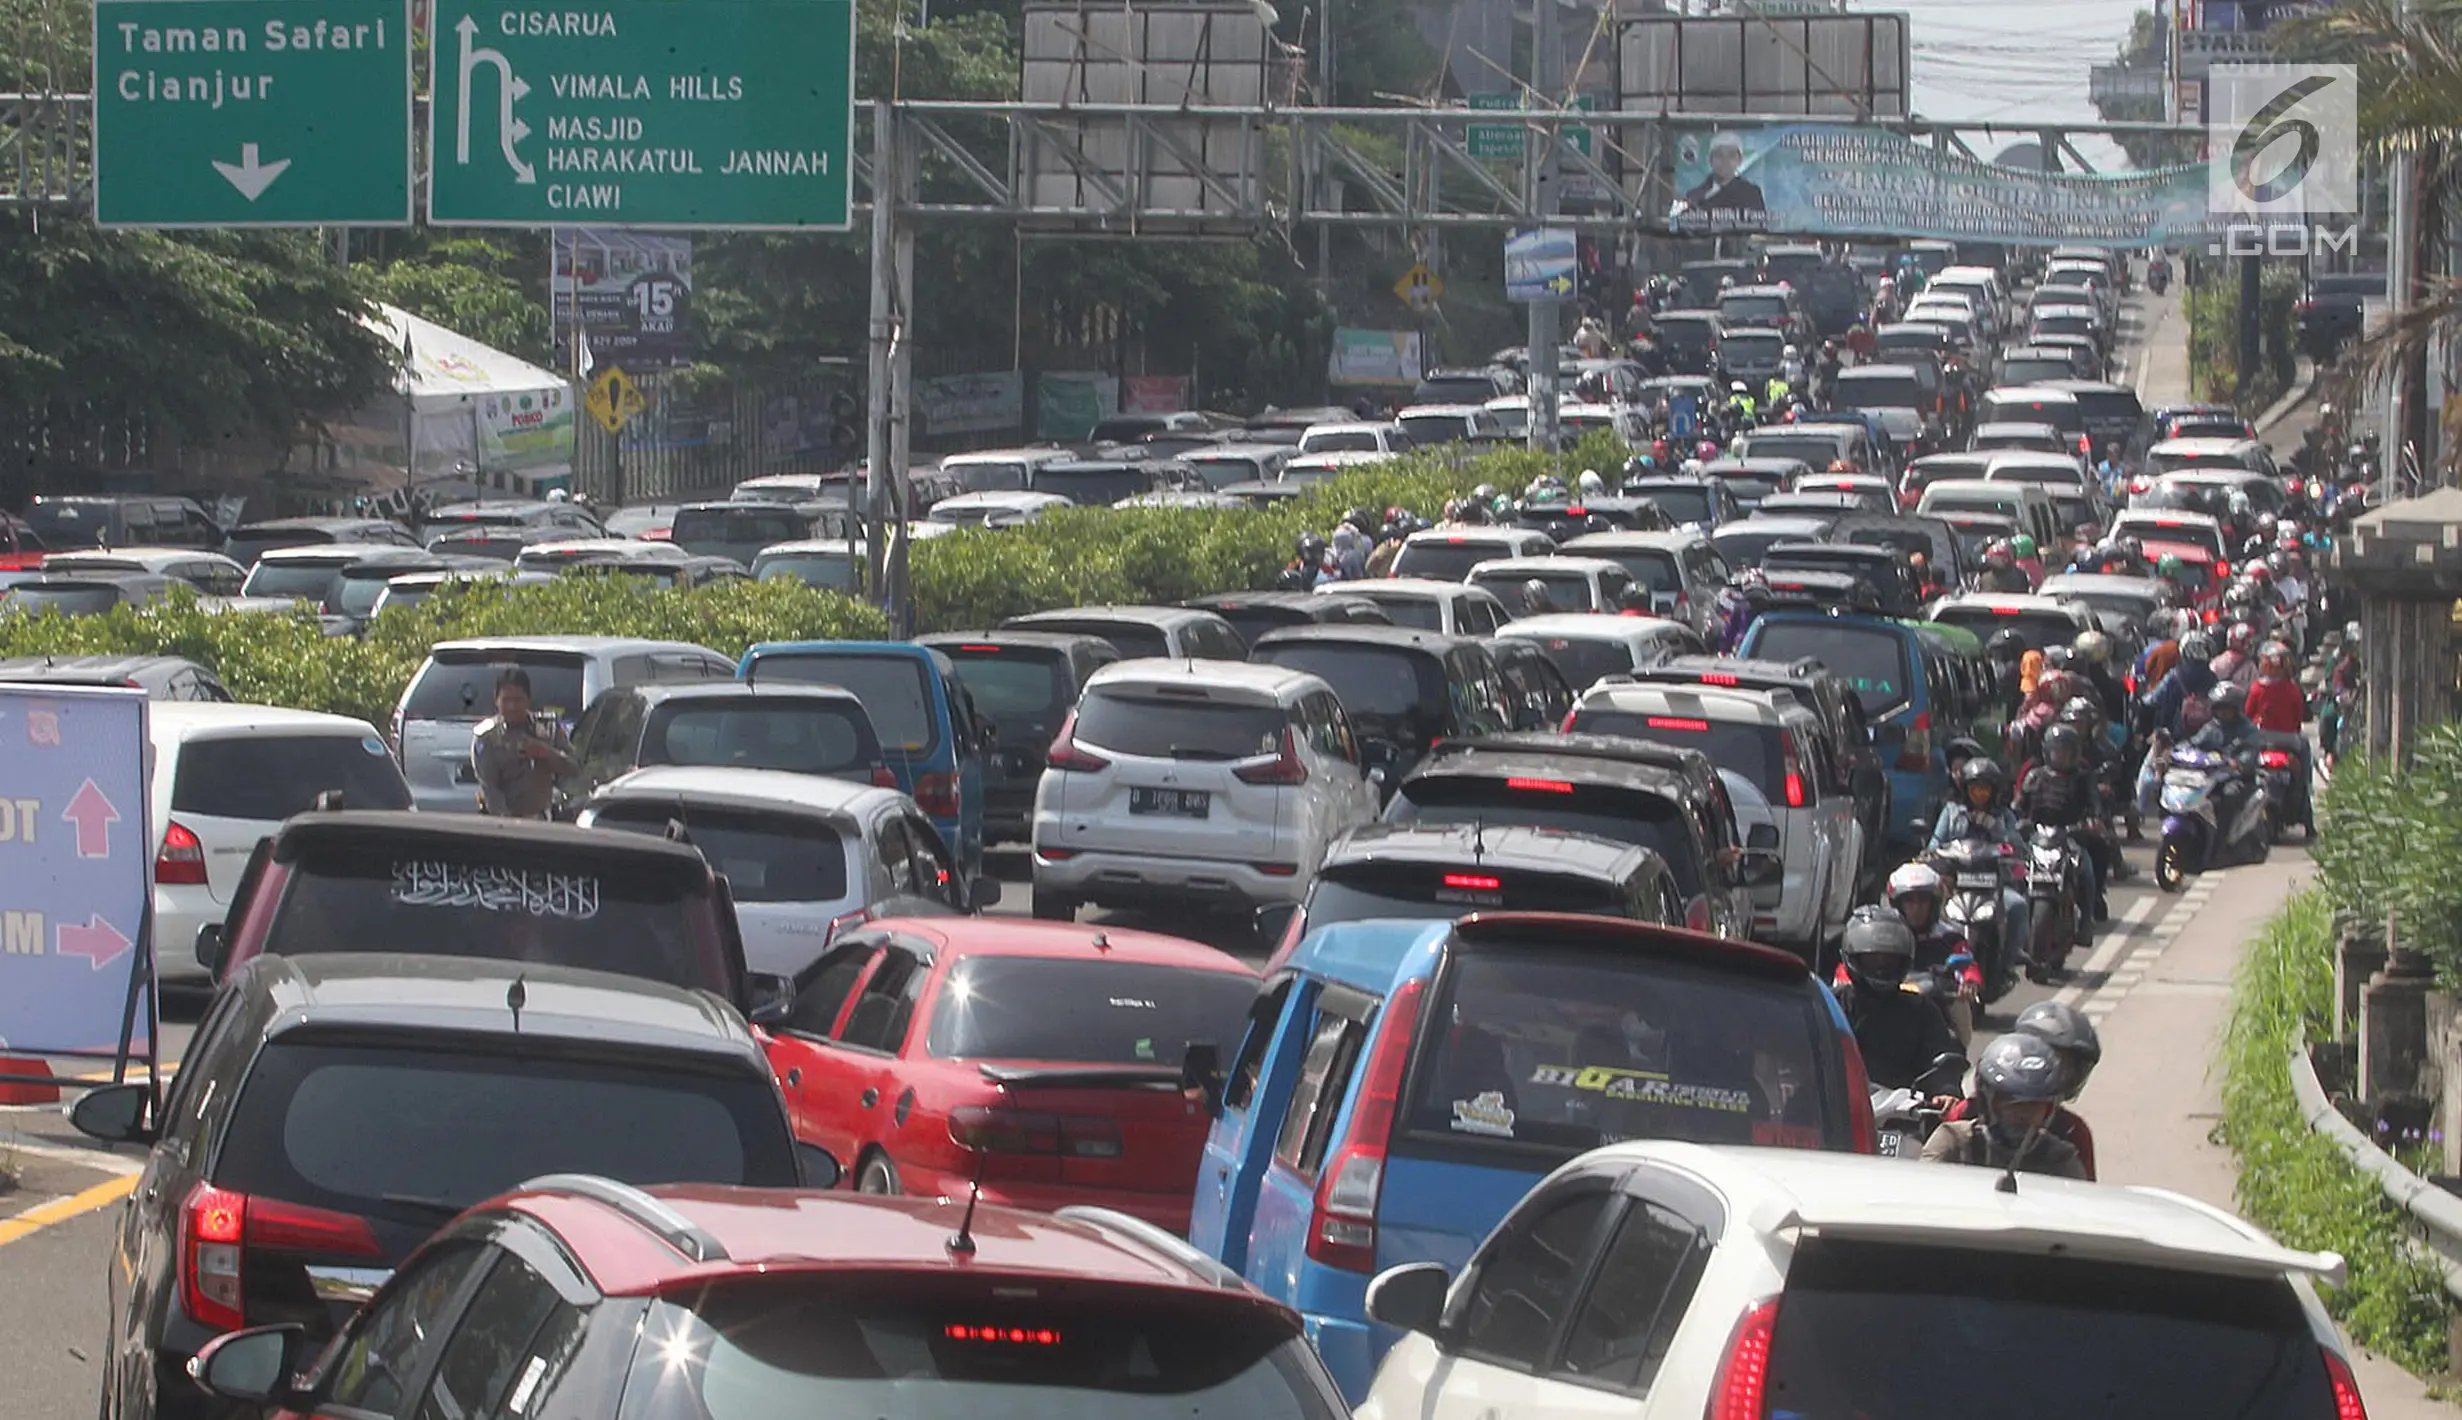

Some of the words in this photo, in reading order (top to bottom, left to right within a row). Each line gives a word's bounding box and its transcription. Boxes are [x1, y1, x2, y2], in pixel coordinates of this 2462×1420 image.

[118, 22, 246, 53] Taman
[265, 18, 386, 51] Safari
[500, 11, 617, 37] CISARUA
[118, 69, 274, 110] Cianjur
[550, 74, 651, 100] VIMALA
[670, 75, 743, 101] HILLS
[548, 115, 643, 141] MASJID
[548, 147, 703, 174] HARAKATUL
[720, 149, 828, 176] JANNAH
[547, 183, 620, 210] CIAWI
[633, 281, 673, 316] 15
[641, 322, 673, 333] AKAD
